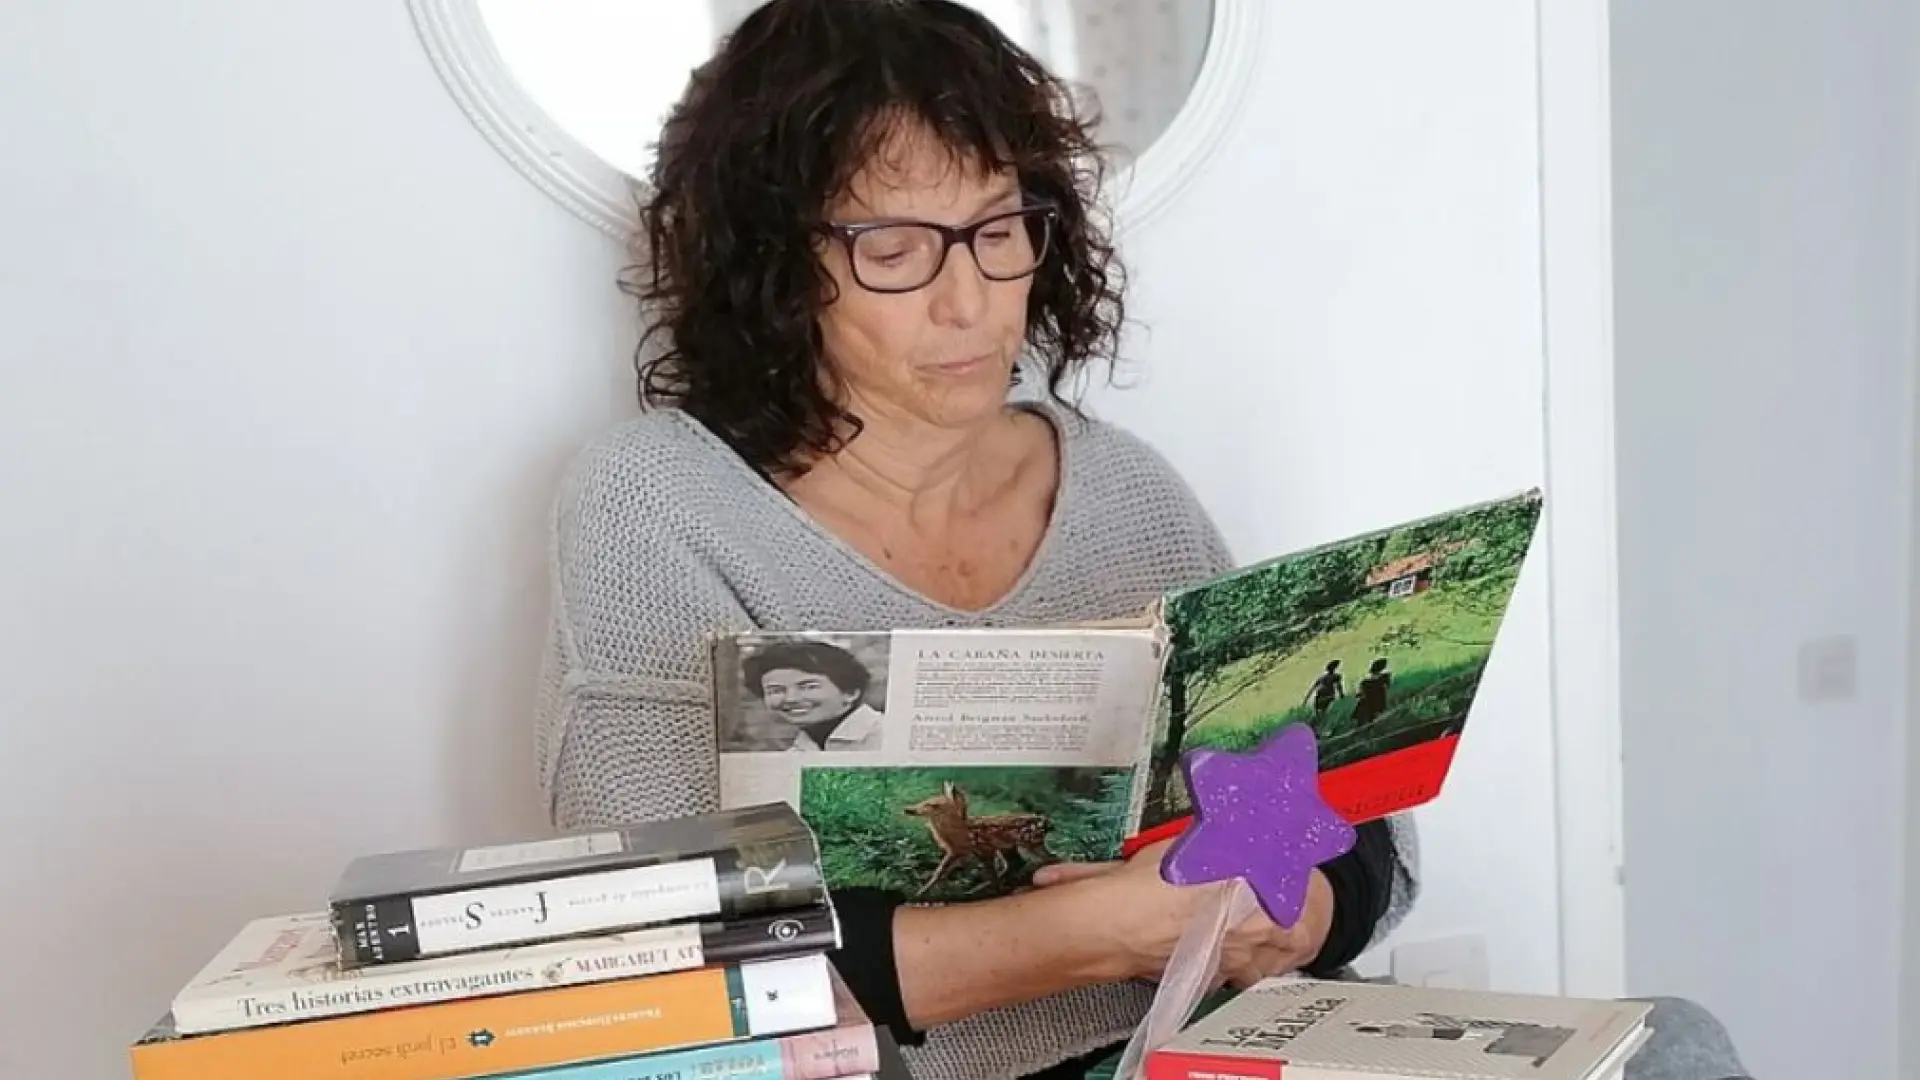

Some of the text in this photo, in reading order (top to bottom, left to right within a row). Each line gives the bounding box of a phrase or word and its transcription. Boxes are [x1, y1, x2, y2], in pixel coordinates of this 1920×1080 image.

[743, 857, 790, 895] R
[387, 924, 411, 937] 1
[238, 997, 287, 1018] Tres
[291, 984, 384, 1011] historias
[390, 967, 534, 999] extravagantes
[576, 948, 669, 973] MARGARET
